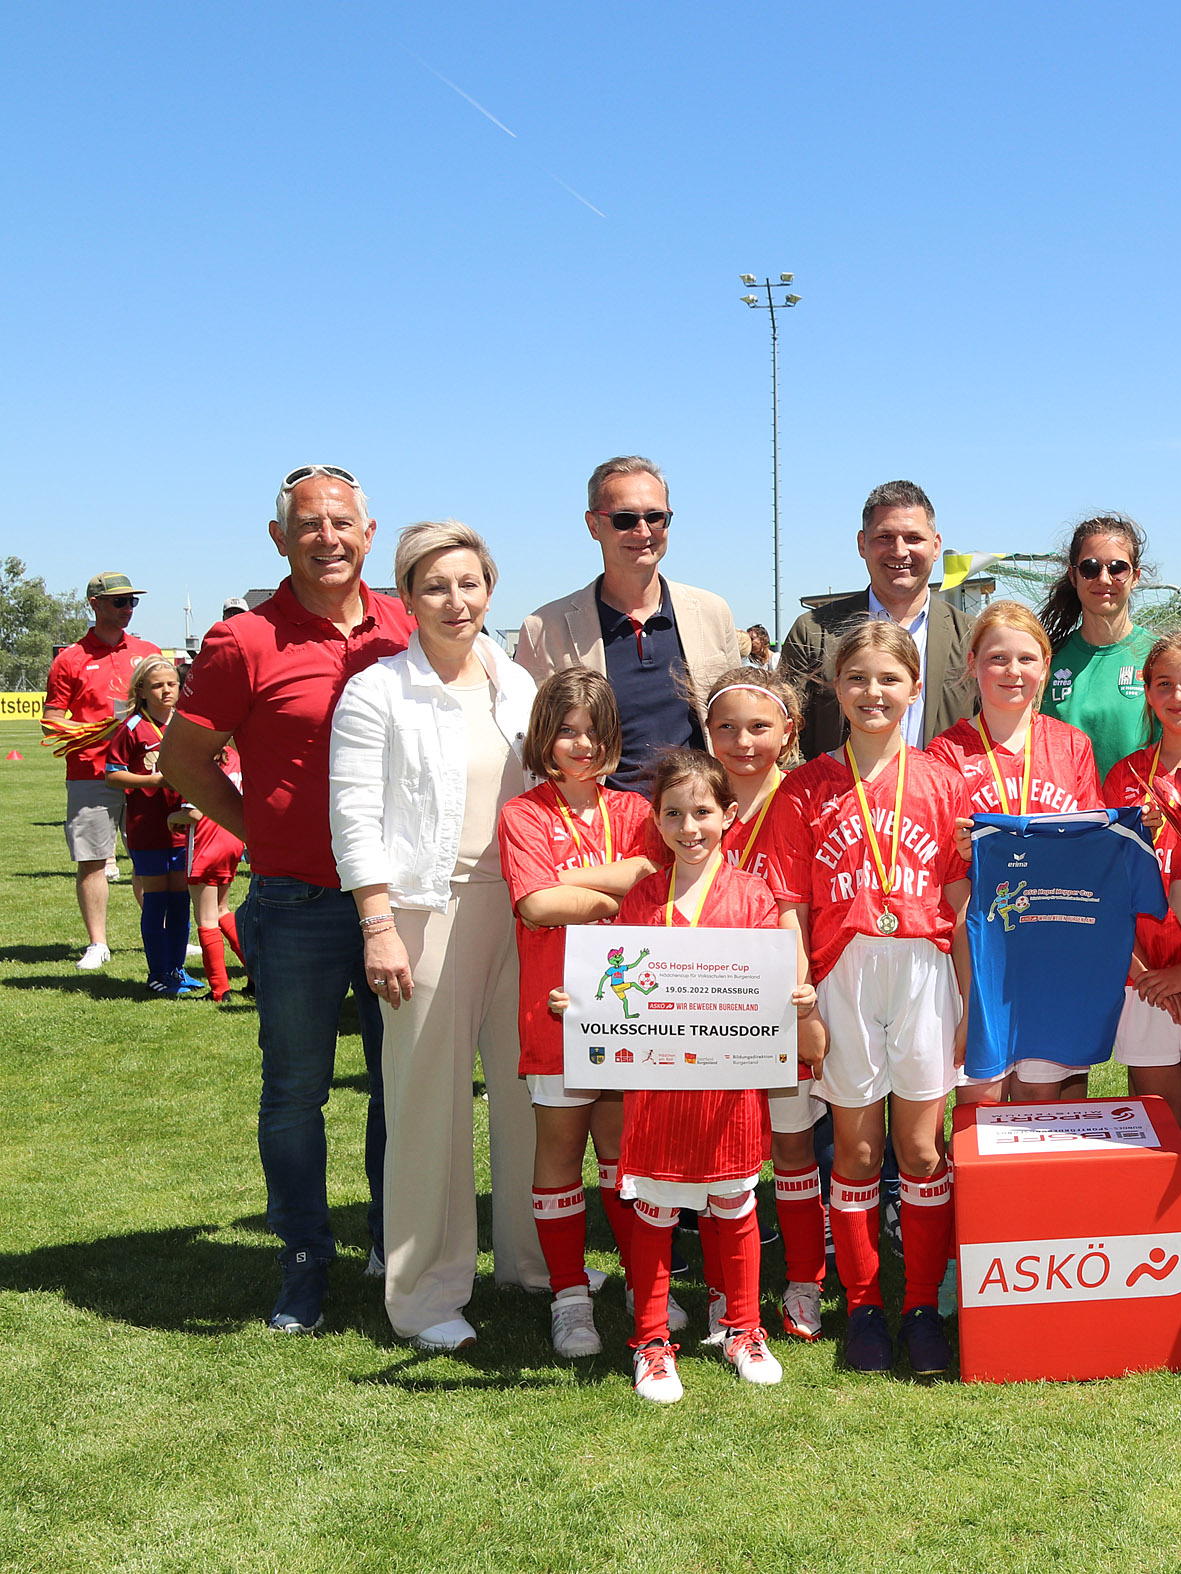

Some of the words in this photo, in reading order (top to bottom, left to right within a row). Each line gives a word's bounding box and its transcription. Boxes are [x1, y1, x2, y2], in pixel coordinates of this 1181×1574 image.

[1052, 687, 1072, 701] LP
[648, 962, 668, 970] OSG
[669, 962, 694, 972] Hopsi
[696, 963, 729, 972] Hopper
[731, 963, 750, 973] Cup
[665, 986, 709, 994] 19.05.2022
[676, 1002, 688, 1010] WIR
[689, 1003, 717, 1011] BEWEGEN
[719, 1003, 759, 1012] BURGENLAND
[580, 1023, 685, 1036] VOLKSSCHULE
[690, 1025, 780, 1037] TRAUSDORF
[990, 1113, 1104, 1124] SPORT
[978, 1243, 1110, 1294] ASKÖ
